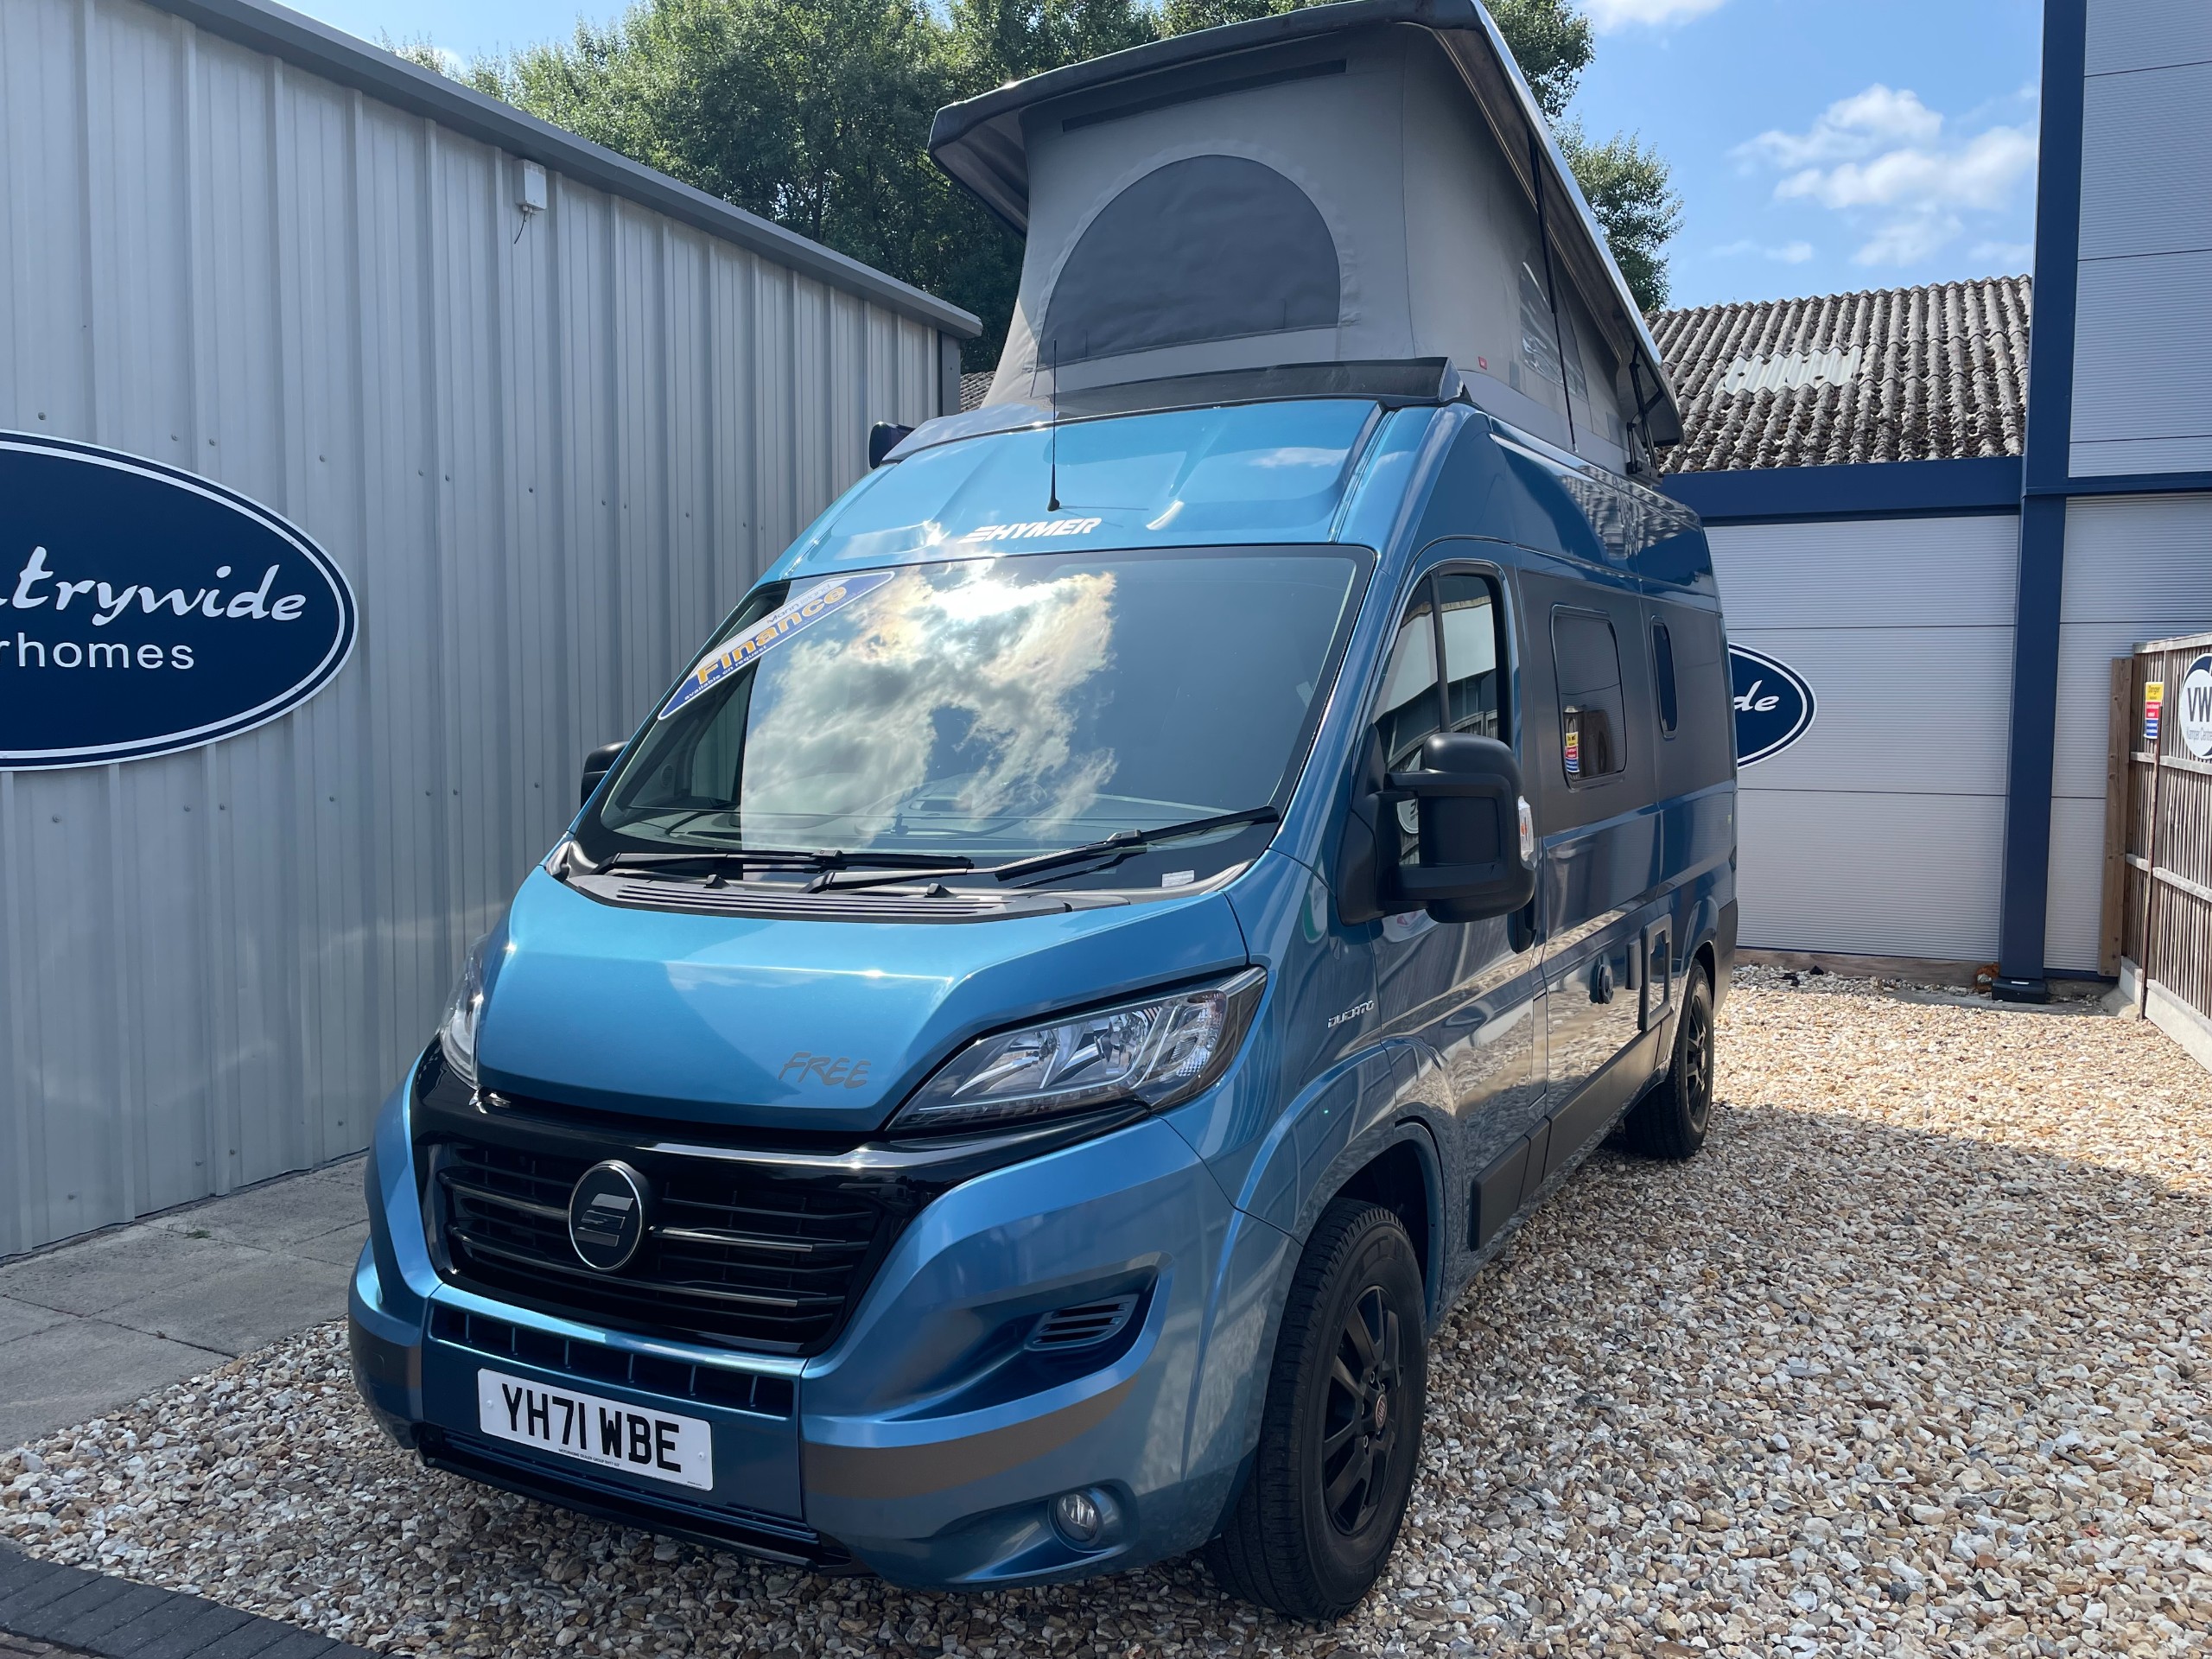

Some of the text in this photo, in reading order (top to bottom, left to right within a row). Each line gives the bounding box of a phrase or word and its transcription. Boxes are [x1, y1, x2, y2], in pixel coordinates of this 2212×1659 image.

[983, 518, 1103, 542] HYMER
[0, 546, 306, 626] trywide
[696, 587, 848, 685] Finance
[766, 602, 799, 624] Mann
[683, 645, 768, 701] available on request
[1327, 1000, 1375, 1028] DUCATO
[779, 1052, 872, 1089] FREE
[502, 1382, 682, 1474] YH71 WBE
